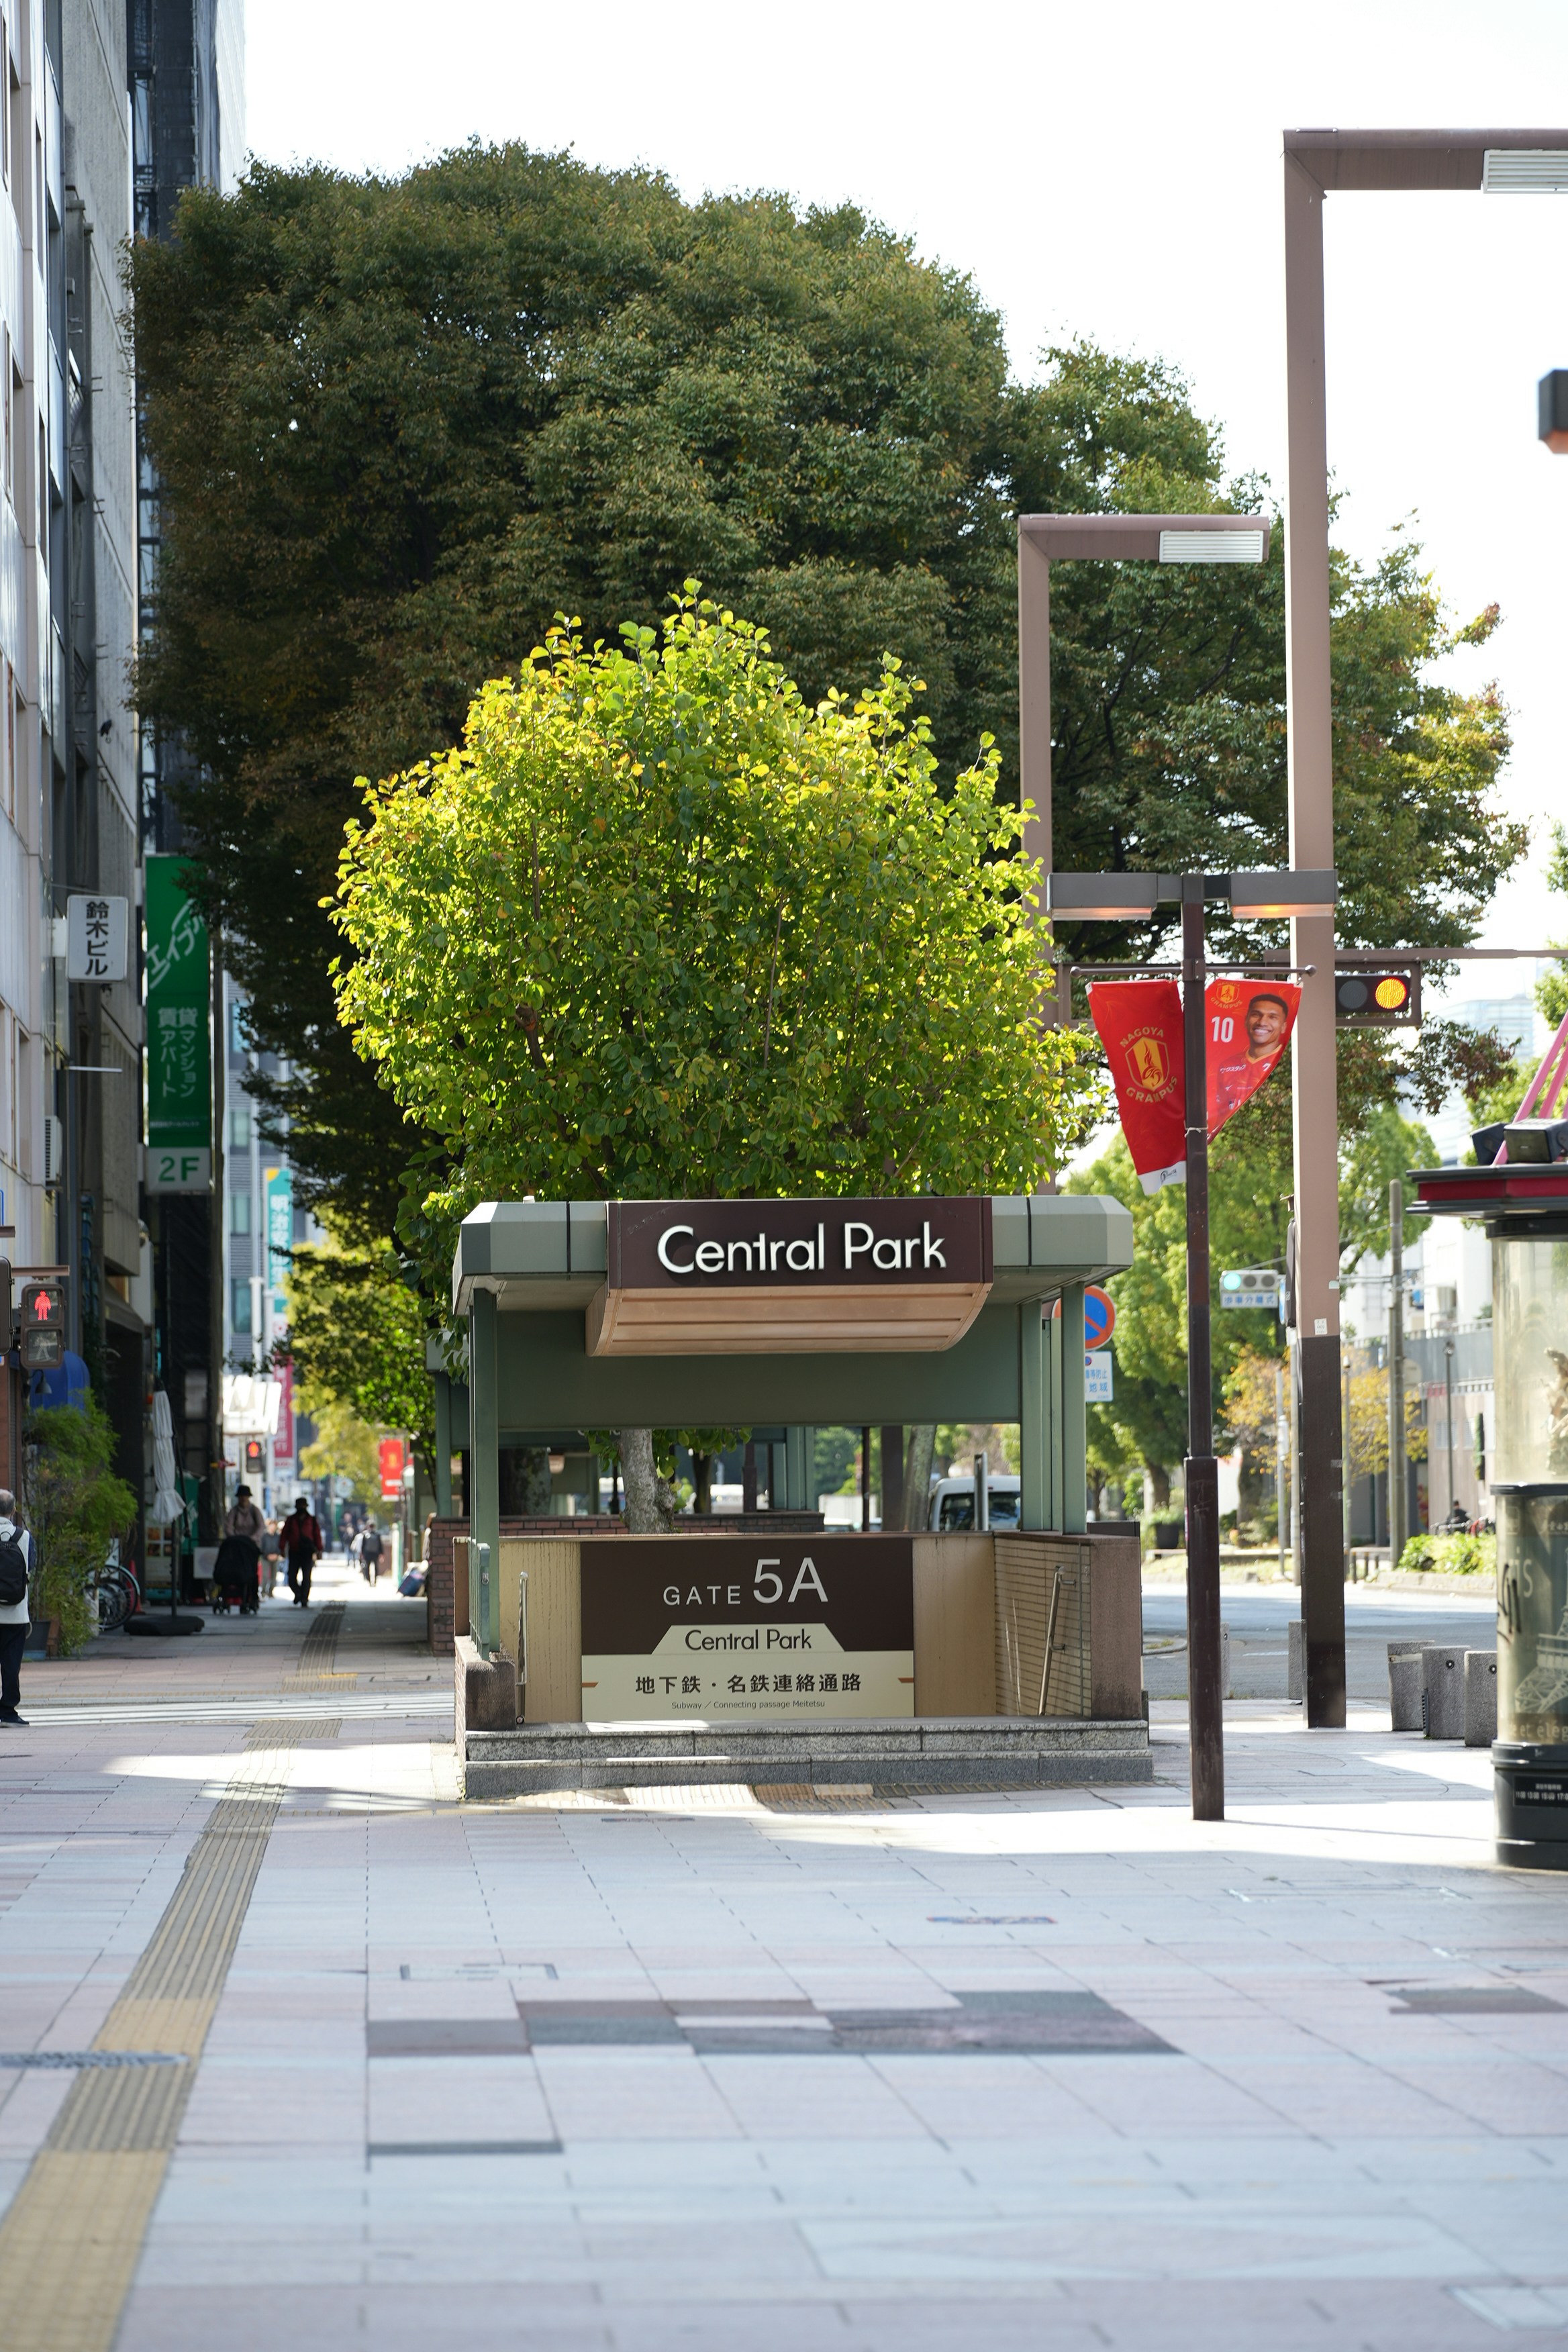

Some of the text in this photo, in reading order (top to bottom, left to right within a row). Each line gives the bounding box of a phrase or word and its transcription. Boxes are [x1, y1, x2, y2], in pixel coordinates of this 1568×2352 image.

[85, 901, 109, 975] 鈴木ビル
[1119, 1026, 1165, 1048] NAGOYA
[1211, 1016, 1234, 1042] 10
[160, 1030, 177, 1097] アパート
[180, 1030, 197, 1097] マンション
[1126, 1076, 1178, 1103] GRAMPUS
[158, 1157, 199, 1181] 2F
[657, 1221, 947, 1273] Central Park
[663, 1557, 828, 1606] GATE 5A
[685, 1628, 812, 1651] Central Park
[636, 1673, 861, 1694] 地下鉄・名鉄連絡通路
[671, 1702, 702, 1710] Subway
[714, 1700, 757, 1710] Connecting
[758, 1702, 791, 1710] passage
[793, 1700, 826, 1708] Meitetsu
